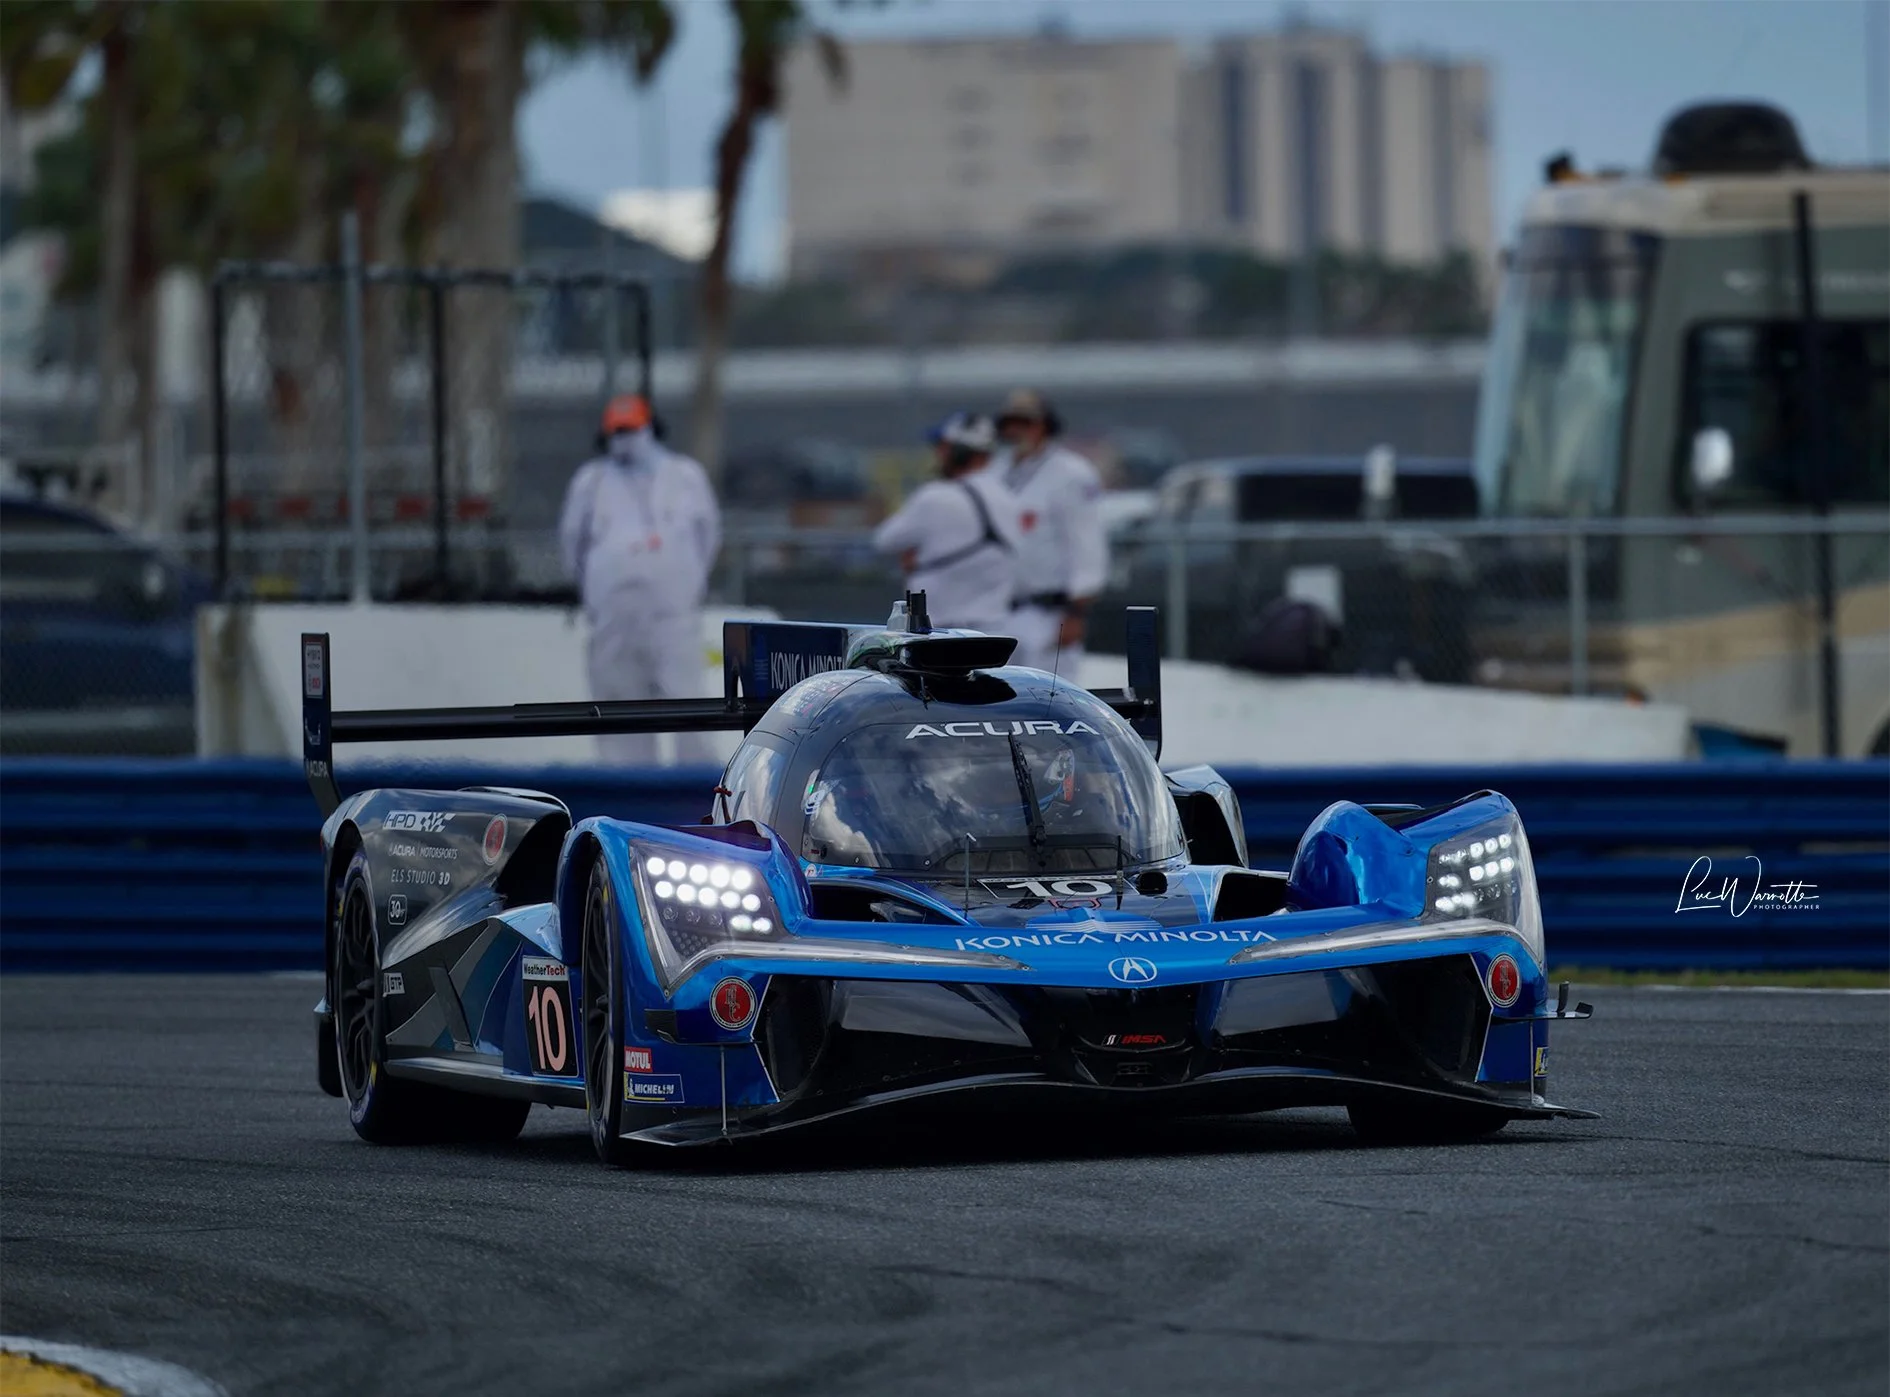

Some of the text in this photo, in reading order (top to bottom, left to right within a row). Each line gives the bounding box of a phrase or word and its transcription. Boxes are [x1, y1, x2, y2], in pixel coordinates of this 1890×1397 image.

[770, 652, 806, 690] KONICA
[905, 720, 1100, 740] ACURA
[383, 813, 417, 829] HPD
[392, 844, 459, 859] ACURA MOTORSPORTS
[391, 869, 451, 886] ELS STUDIO 3D
[1007, 880, 1113, 898] 10
[955, 929, 1278, 951] KONICA MINOLTA
[523, 962, 566, 977] WeatherTech
[528, 985, 567, 1073] 10
[624, 1051, 652, 1069] MOTUL
